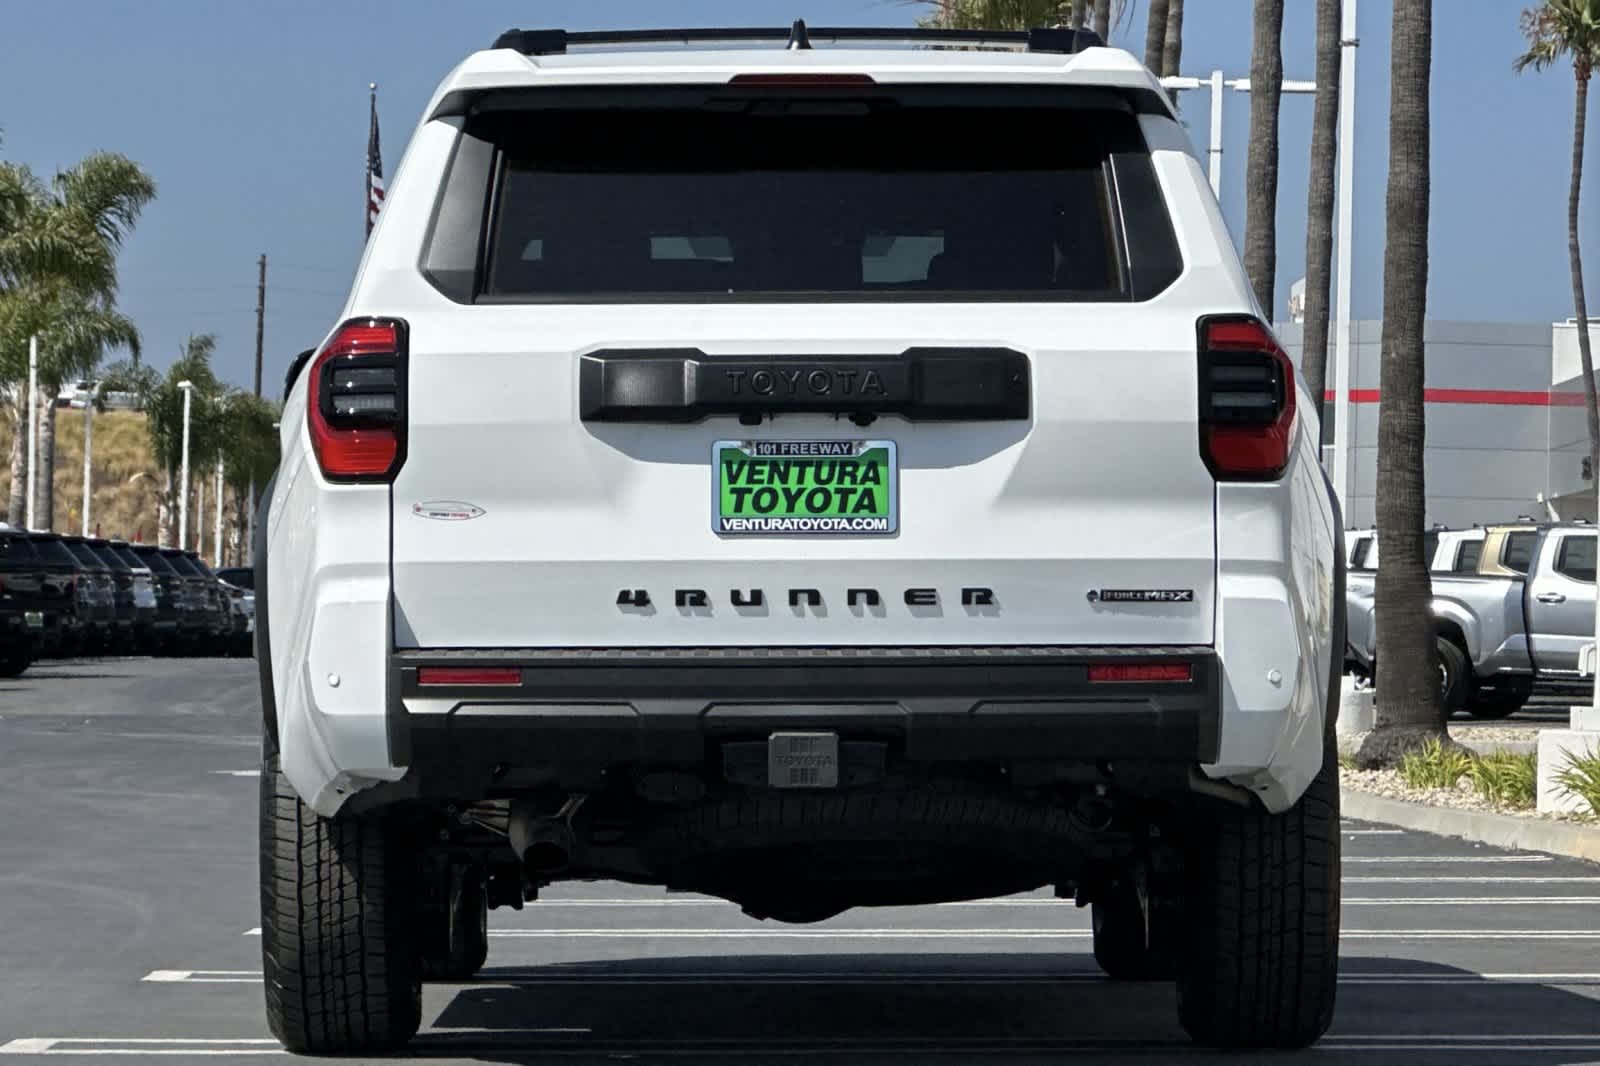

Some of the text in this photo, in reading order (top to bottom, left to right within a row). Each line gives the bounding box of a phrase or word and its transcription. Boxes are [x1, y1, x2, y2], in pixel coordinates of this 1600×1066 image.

[726, 370, 888, 395] TOYOTA
[758, 443, 851, 455] 101 FREEWAY
[724, 460, 881, 485] VENTURA
[729, 487, 878, 514] TOYOTA
[722, 518, 888, 530] VENTURATOYOTA.COM
[616, 588, 994, 607] 4RUNNER
